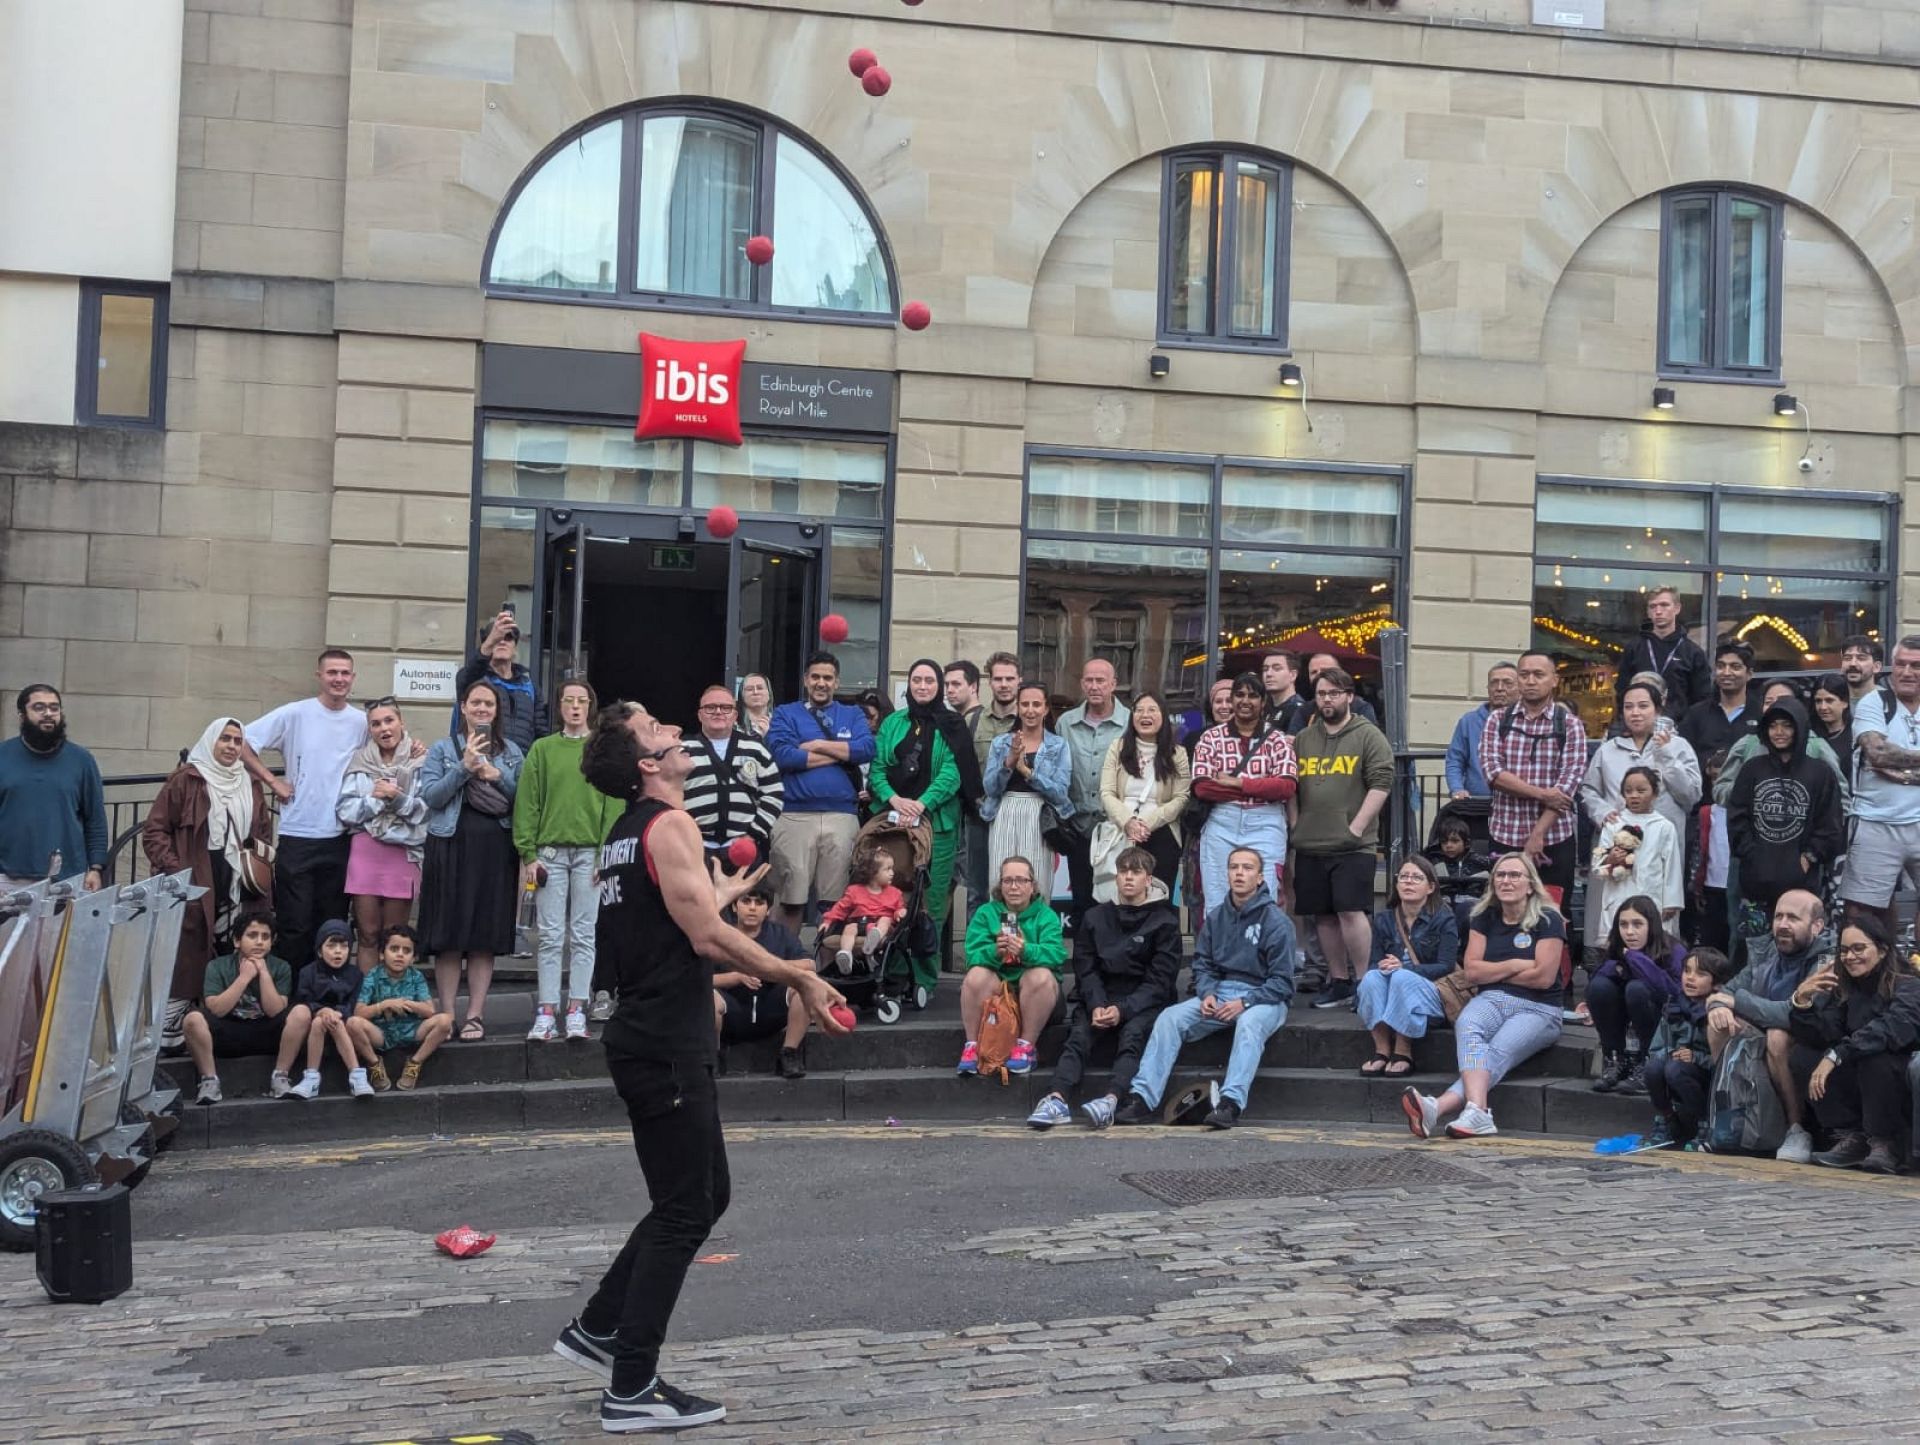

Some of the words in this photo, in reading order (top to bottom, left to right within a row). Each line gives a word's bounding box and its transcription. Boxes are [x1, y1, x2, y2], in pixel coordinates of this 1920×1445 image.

[655, 359, 729, 405] ibis
[760, 375, 824, 398] Edinburgh
[827, 380, 873, 397] Centre
[759, 397, 794, 418] Royal
[798, 400, 828, 417] Mile
[675, 414, 708, 423] HOTELS
[400, 668, 452, 679] Automatic
[410, 681, 441, 691] Doors
